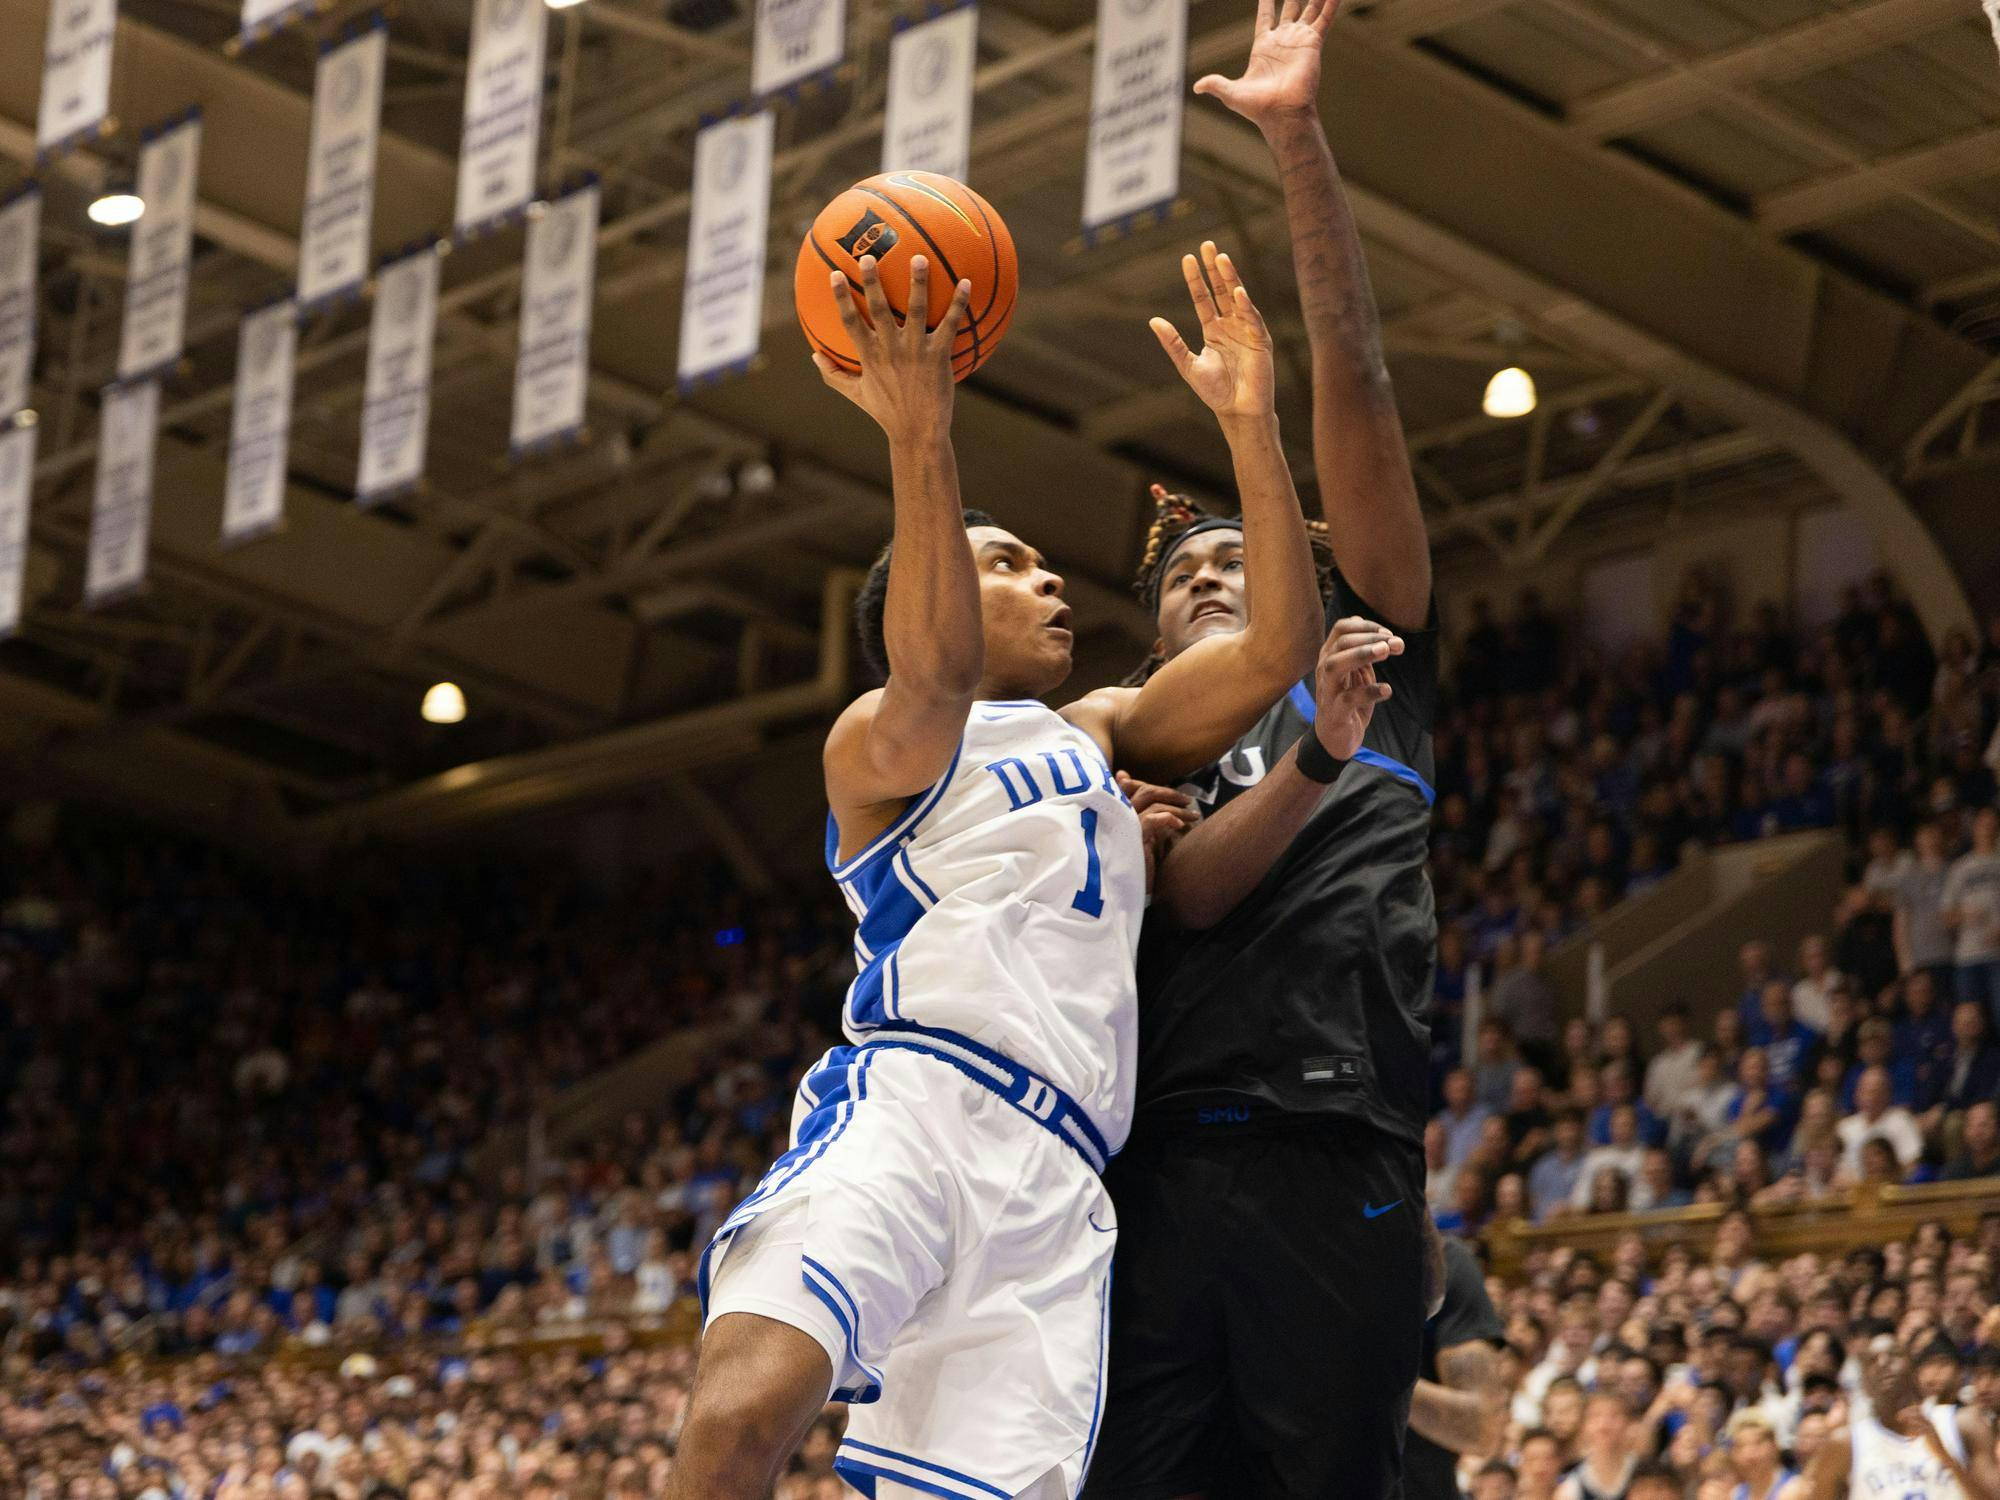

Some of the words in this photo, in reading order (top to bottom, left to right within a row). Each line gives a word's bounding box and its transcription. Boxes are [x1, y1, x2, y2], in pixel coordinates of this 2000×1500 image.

[1072, 807, 1104, 919] 1
[1341, 1062, 1354, 1074] XL
[1017, 1075, 1057, 1120] D
[1199, 1105, 1249, 1124] SMU
